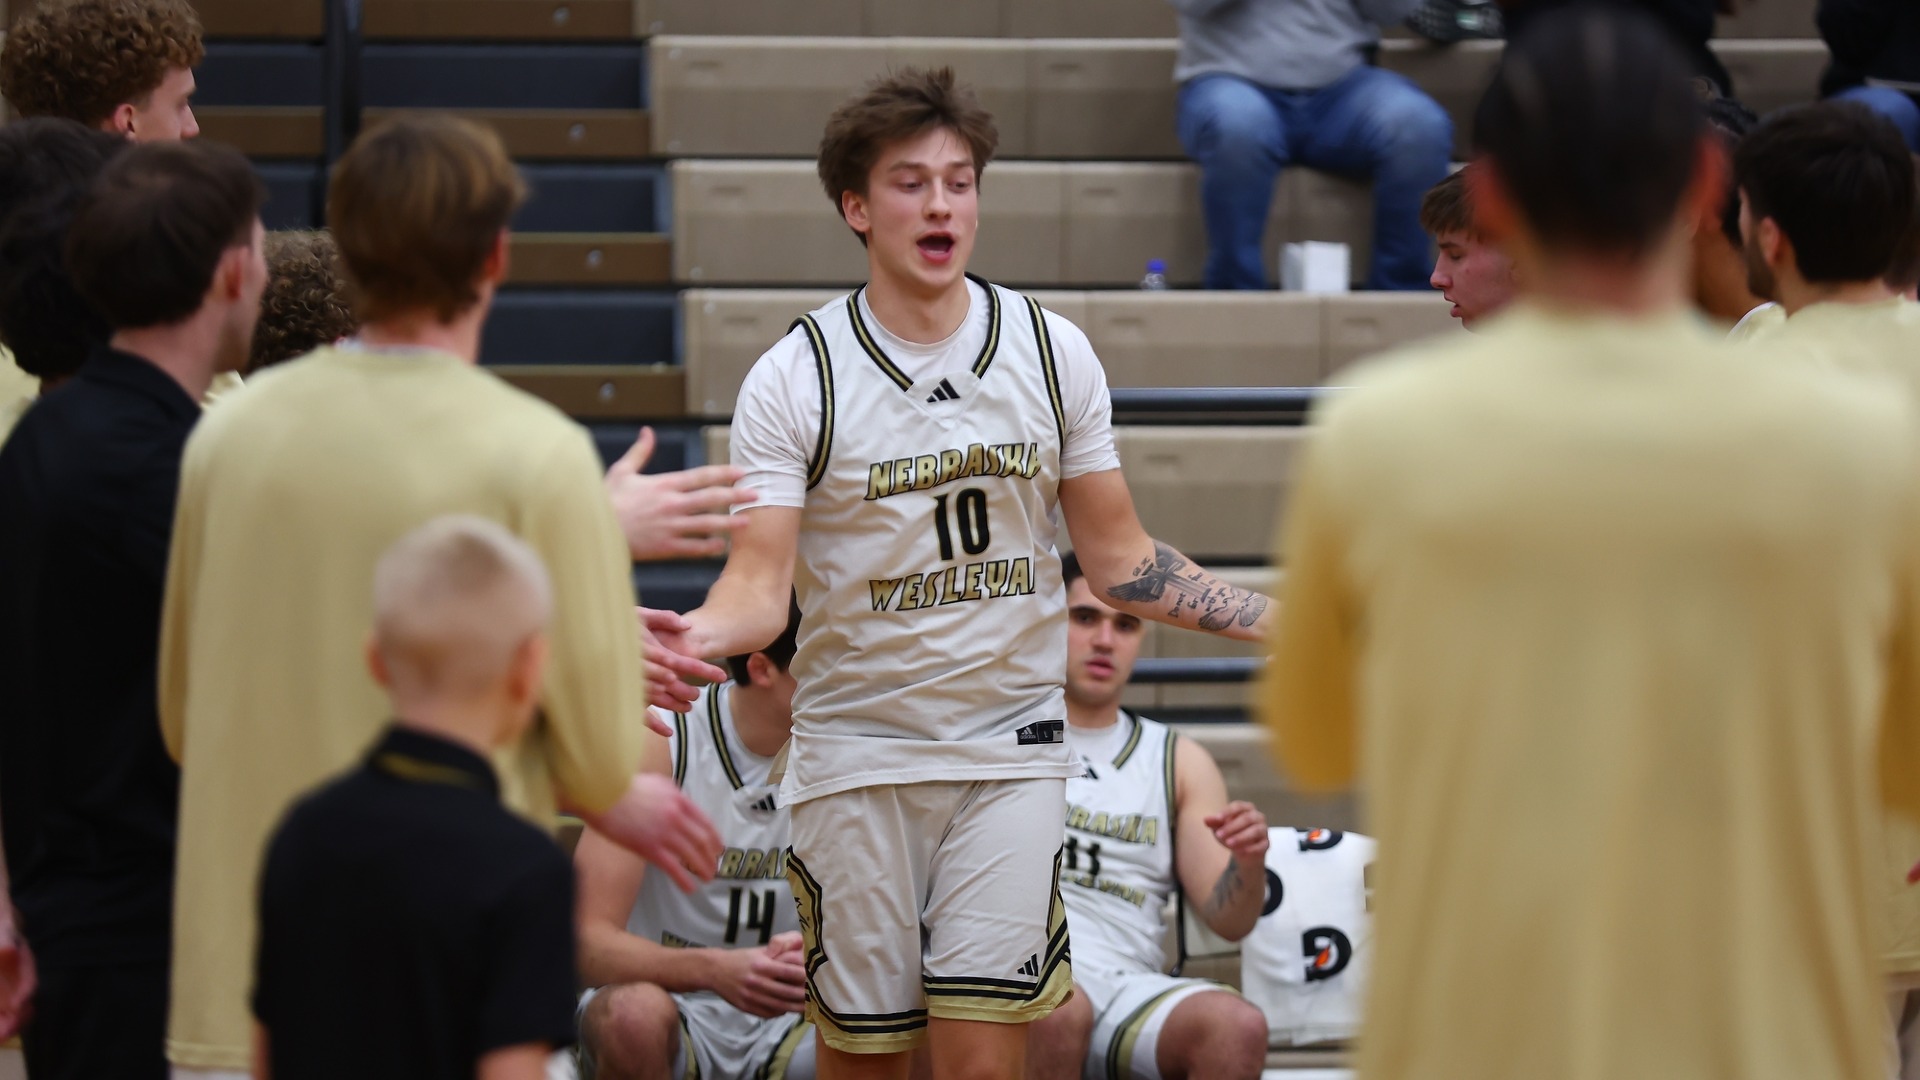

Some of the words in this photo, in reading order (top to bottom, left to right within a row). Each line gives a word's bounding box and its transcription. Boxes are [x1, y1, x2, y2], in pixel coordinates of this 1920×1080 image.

[933, 487, 990, 560] 10
[868, 557, 1036, 611] WESLEYA
[1065, 802, 1158, 846] RASKA
[723, 886, 776, 945] 14
